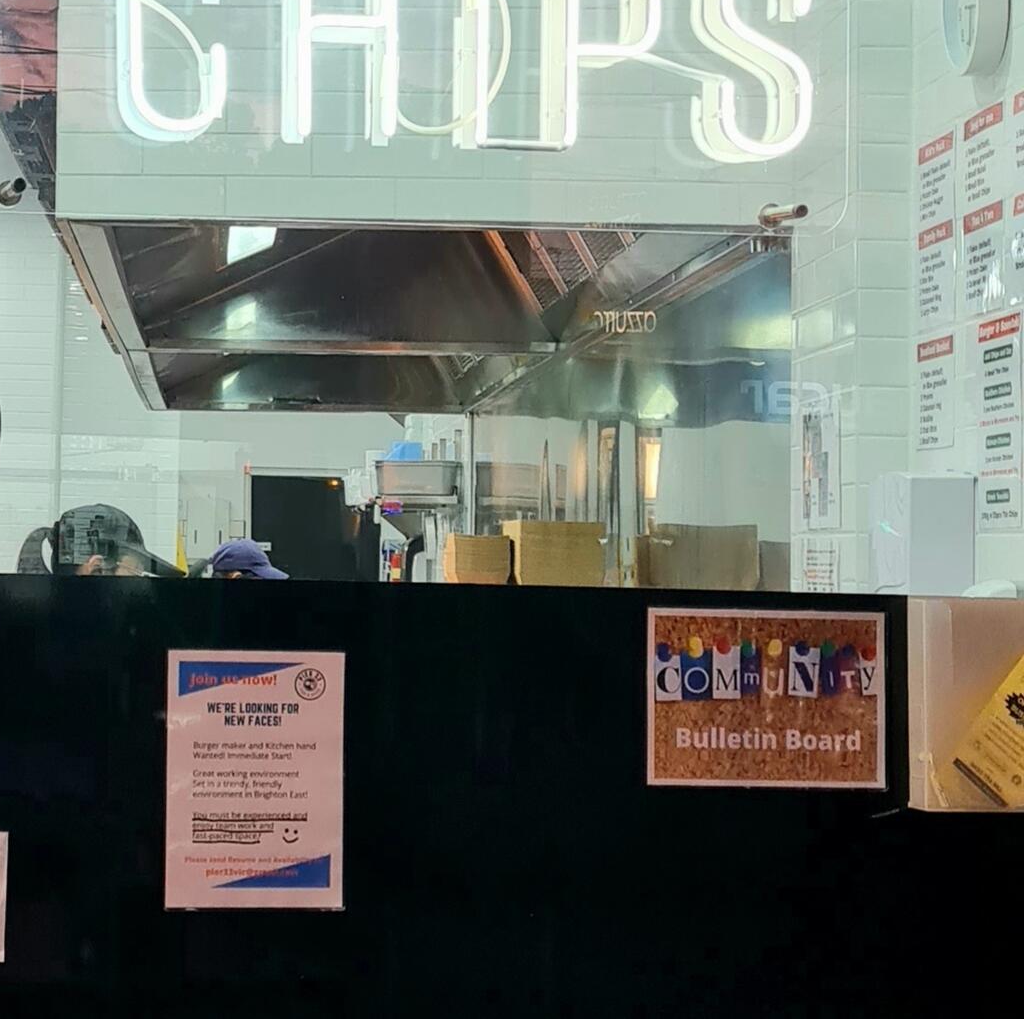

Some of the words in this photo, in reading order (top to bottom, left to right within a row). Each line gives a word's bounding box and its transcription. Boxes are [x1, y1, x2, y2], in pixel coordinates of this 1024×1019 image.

[239, 702, 278, 714] LOOKING
[281, 703, 300, 714] FOR
[224, 715, 246, 727] NEW
[248, 715, 282, 727] FACES!
[676, 727, 777, 750] Bulletin
[785, 729, 861, 752] Board
